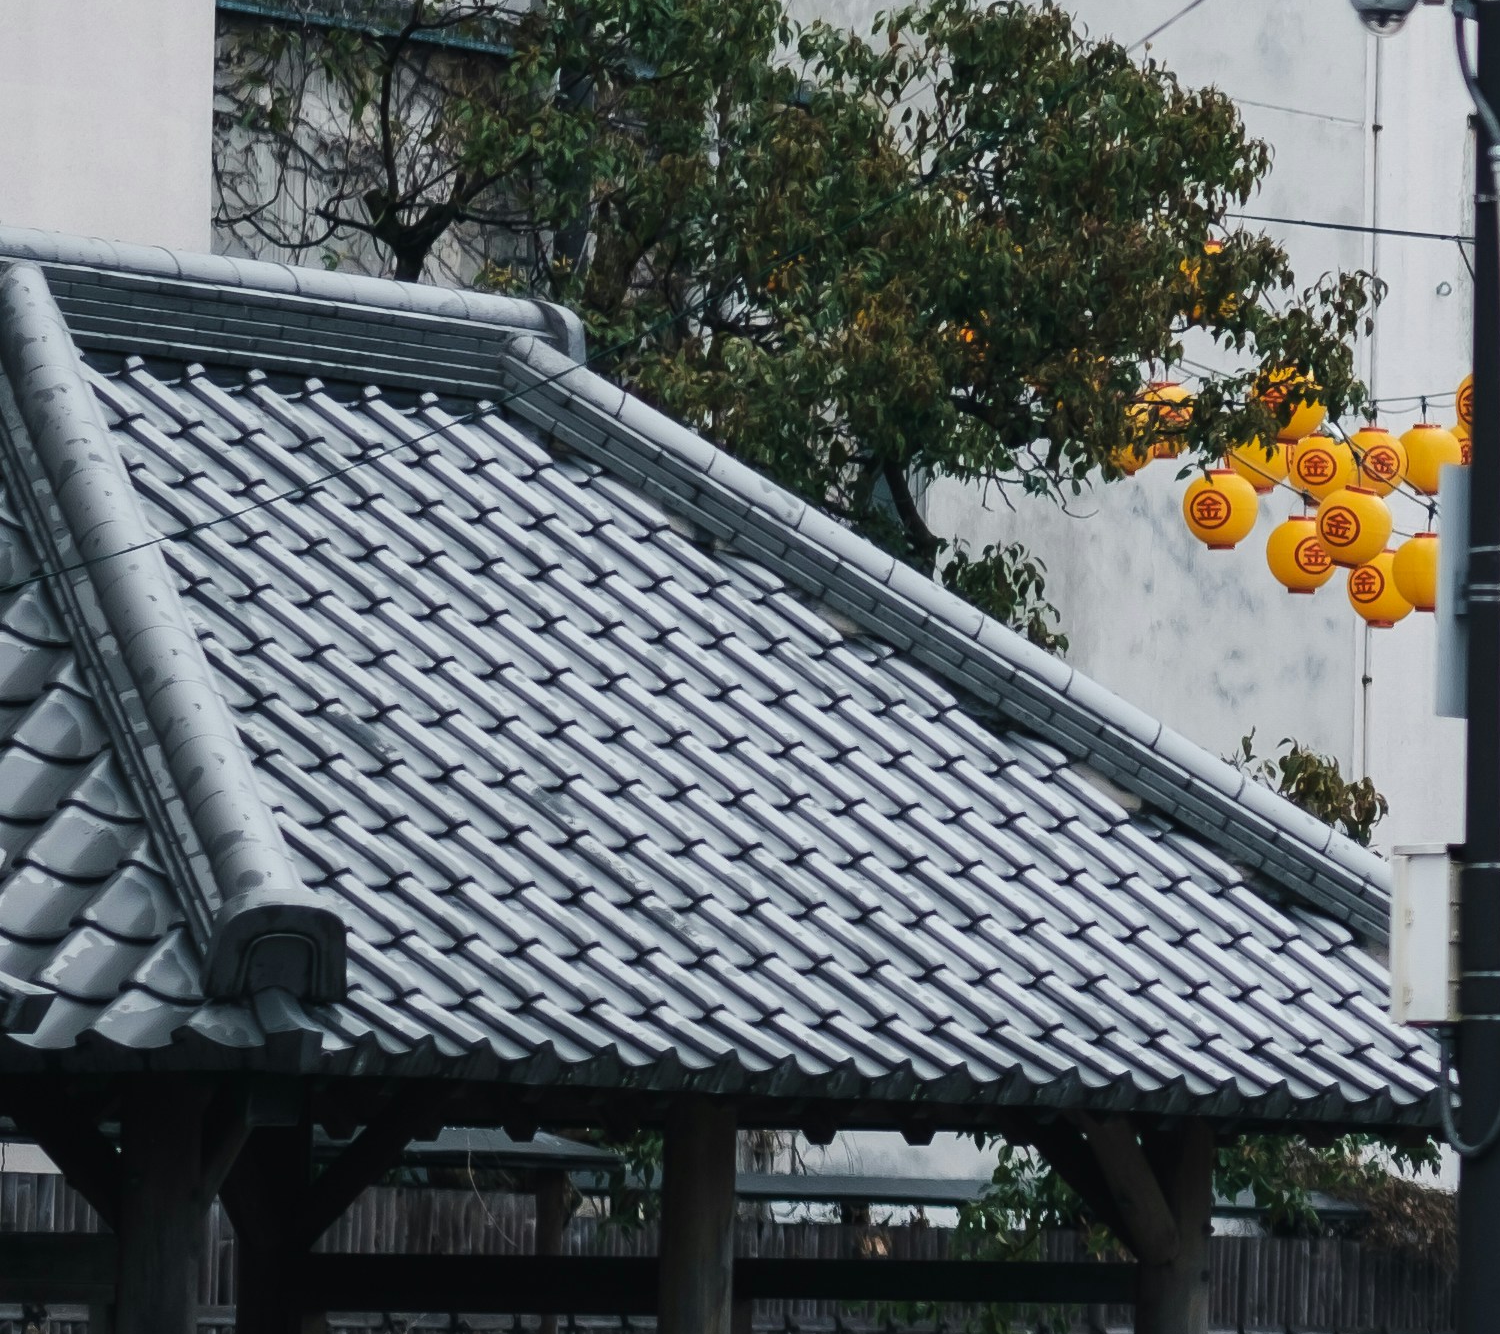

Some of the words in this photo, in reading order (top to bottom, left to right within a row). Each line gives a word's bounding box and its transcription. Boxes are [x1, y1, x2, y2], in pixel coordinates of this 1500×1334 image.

[1304, 455, 1330, 479] 金
[1371, 451, 1393, 476] 金
[1198, 496, 1224, 522] 金
[1327, 513, 1353, 539] 金
[1303, 541, 1331, 568] 金
[1354, 571, 1378, 596] 金
